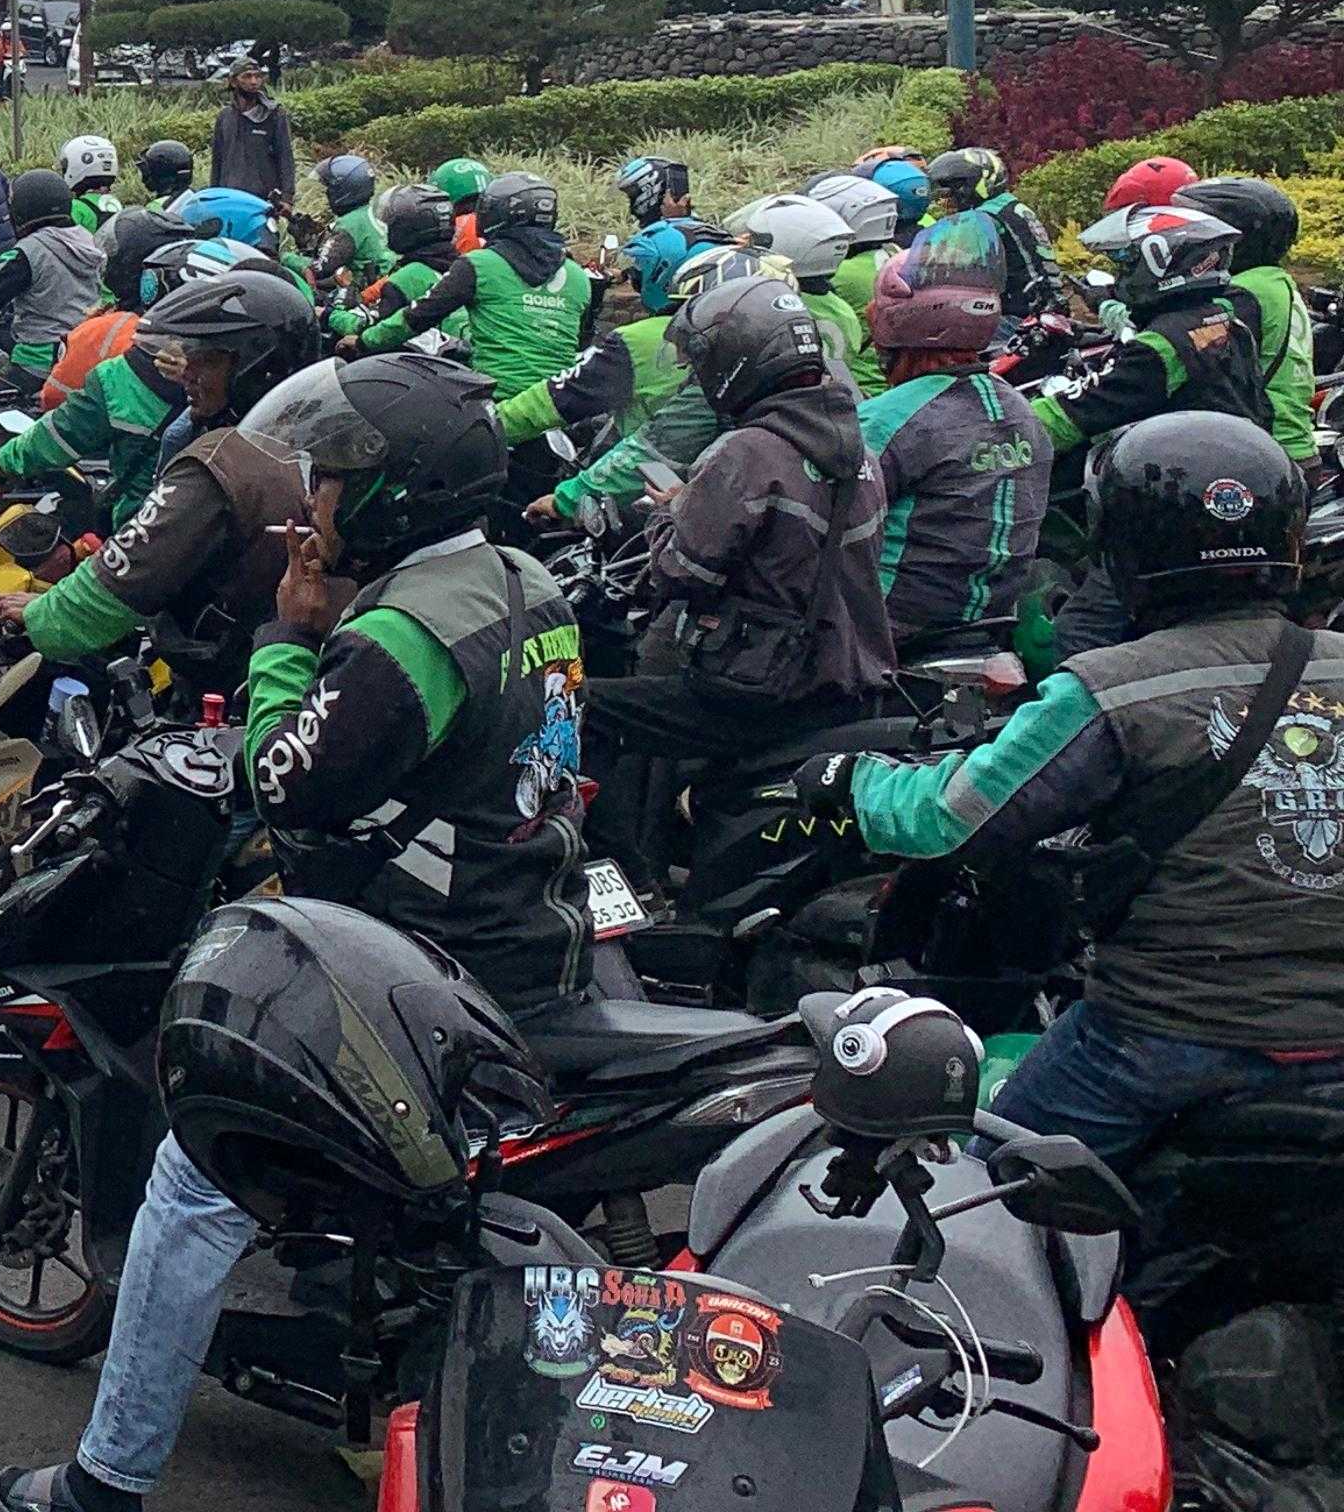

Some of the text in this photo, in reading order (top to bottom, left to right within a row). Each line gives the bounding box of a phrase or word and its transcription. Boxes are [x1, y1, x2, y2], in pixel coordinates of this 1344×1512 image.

[973, 301, 995, 311] GM
[970, 432, 1033, 471] Grab
[102, 482, 177, 577] gojek
[1200, 547, 1268, 560] HONDA
[258, 677, 343, 805] gojek
[573, 1444, 689, 1485] EJM
